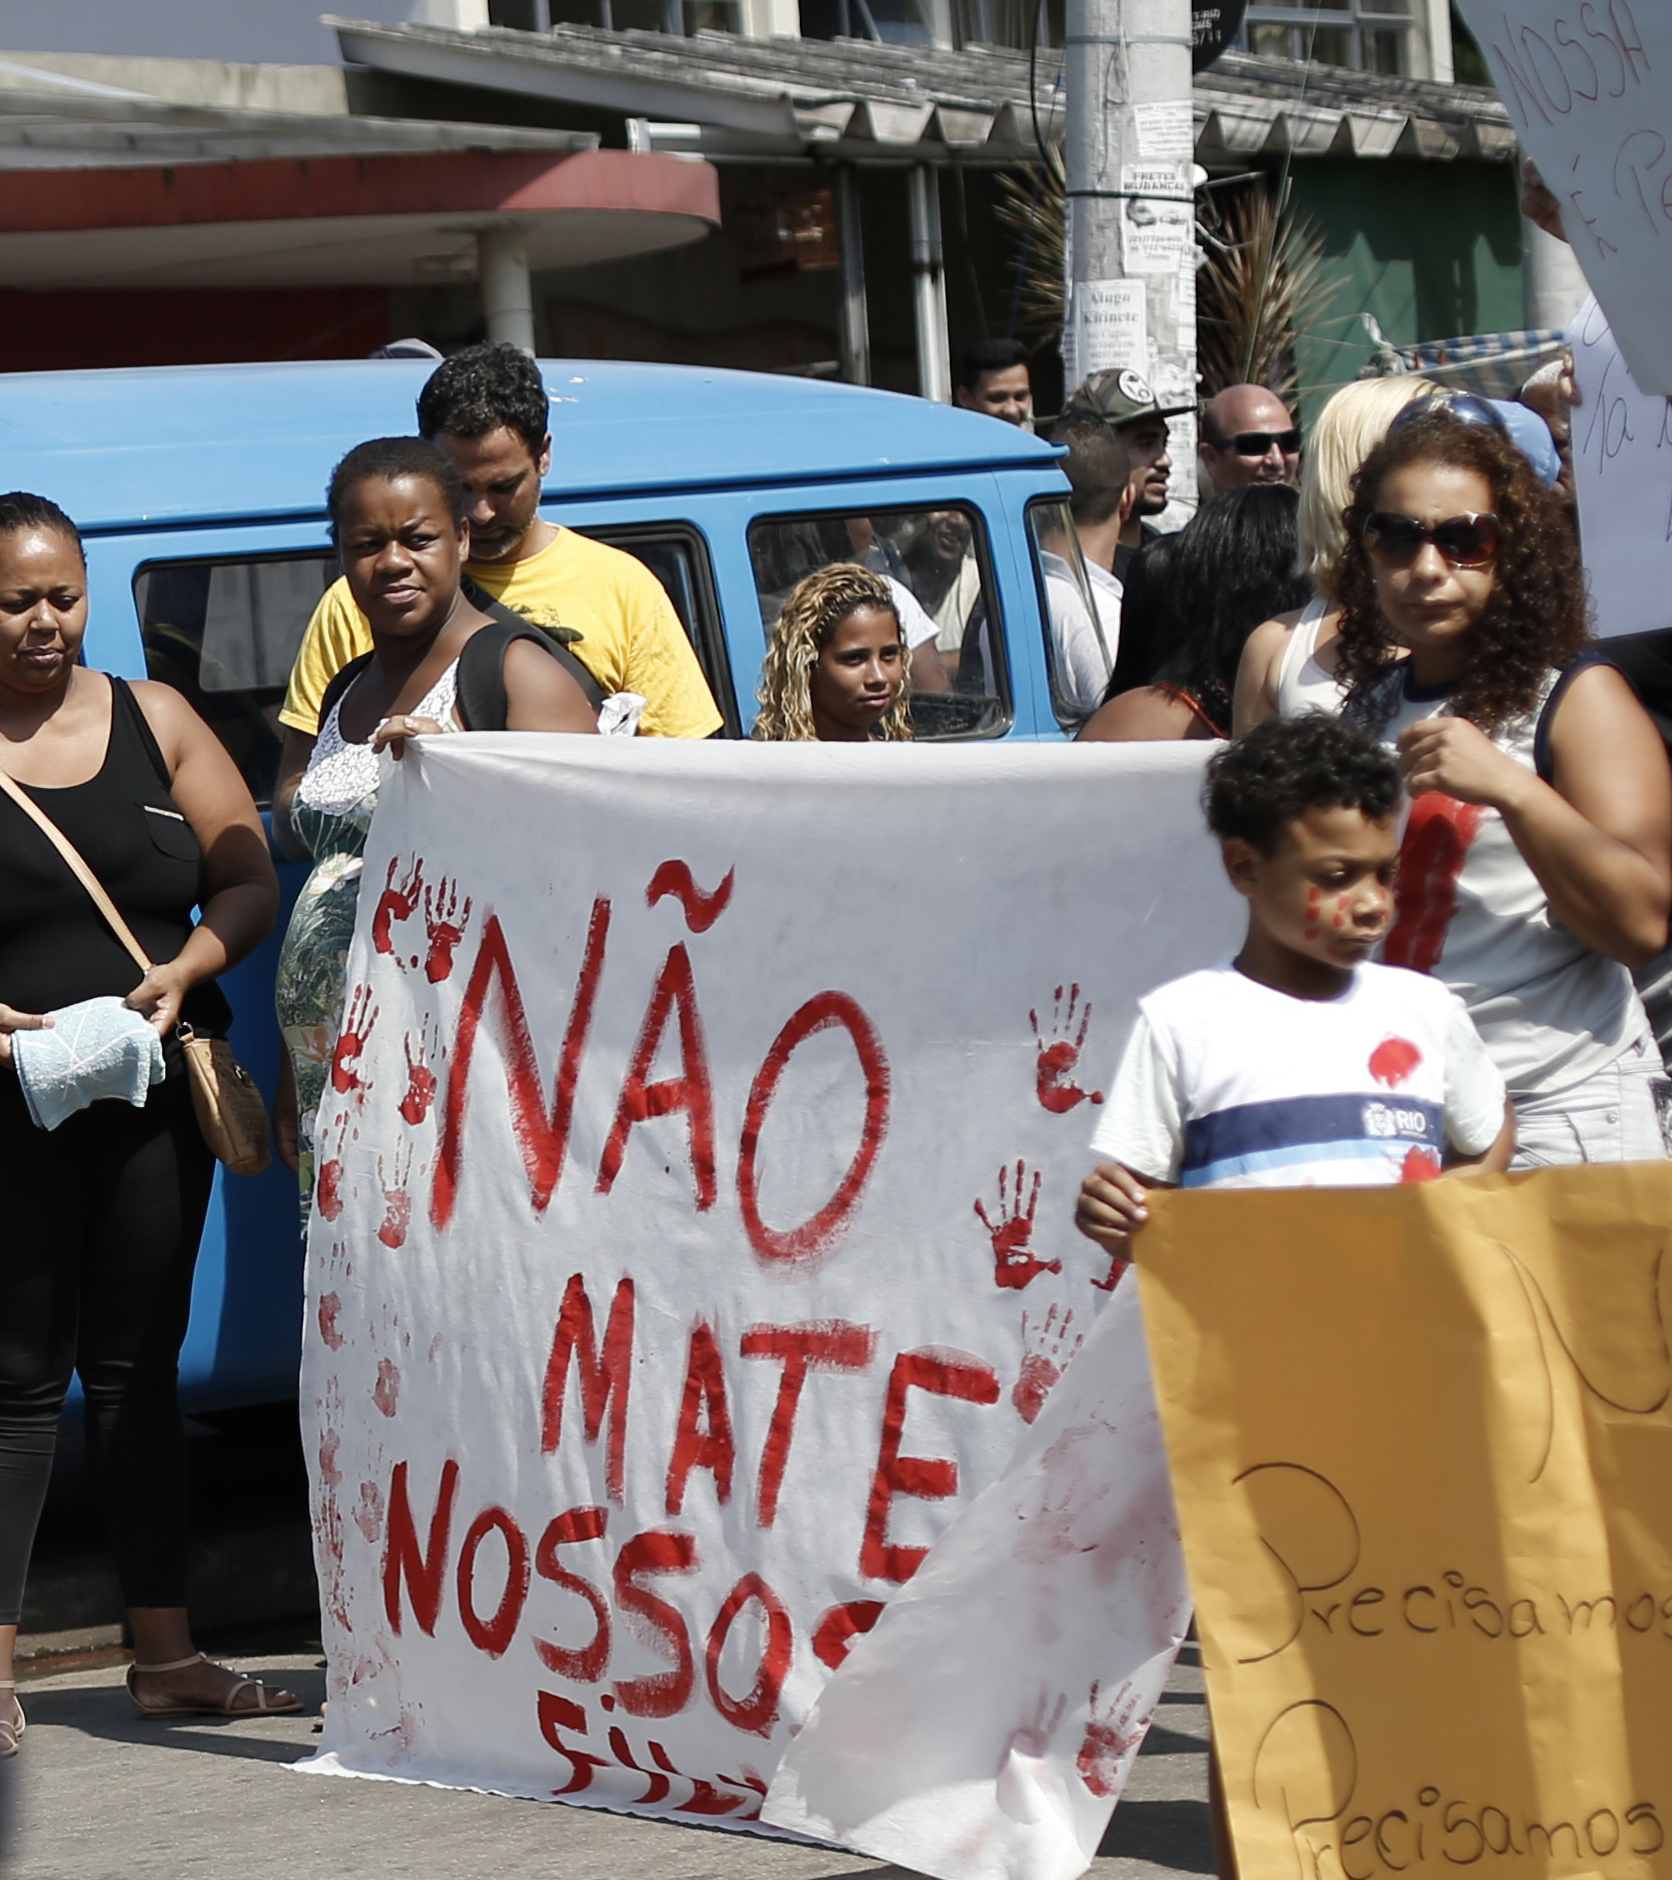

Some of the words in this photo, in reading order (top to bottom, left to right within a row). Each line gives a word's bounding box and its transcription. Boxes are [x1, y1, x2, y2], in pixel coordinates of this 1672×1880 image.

[1492, 0, 1652, 128] NOSSA
[429, 858, 891, 1266] NÃO
[1396, 1110, 1426, 1132] RIO
[540, 1271, 1002, 1584] MATE
[1253, 1699, 1664, 1880] Precisamos
